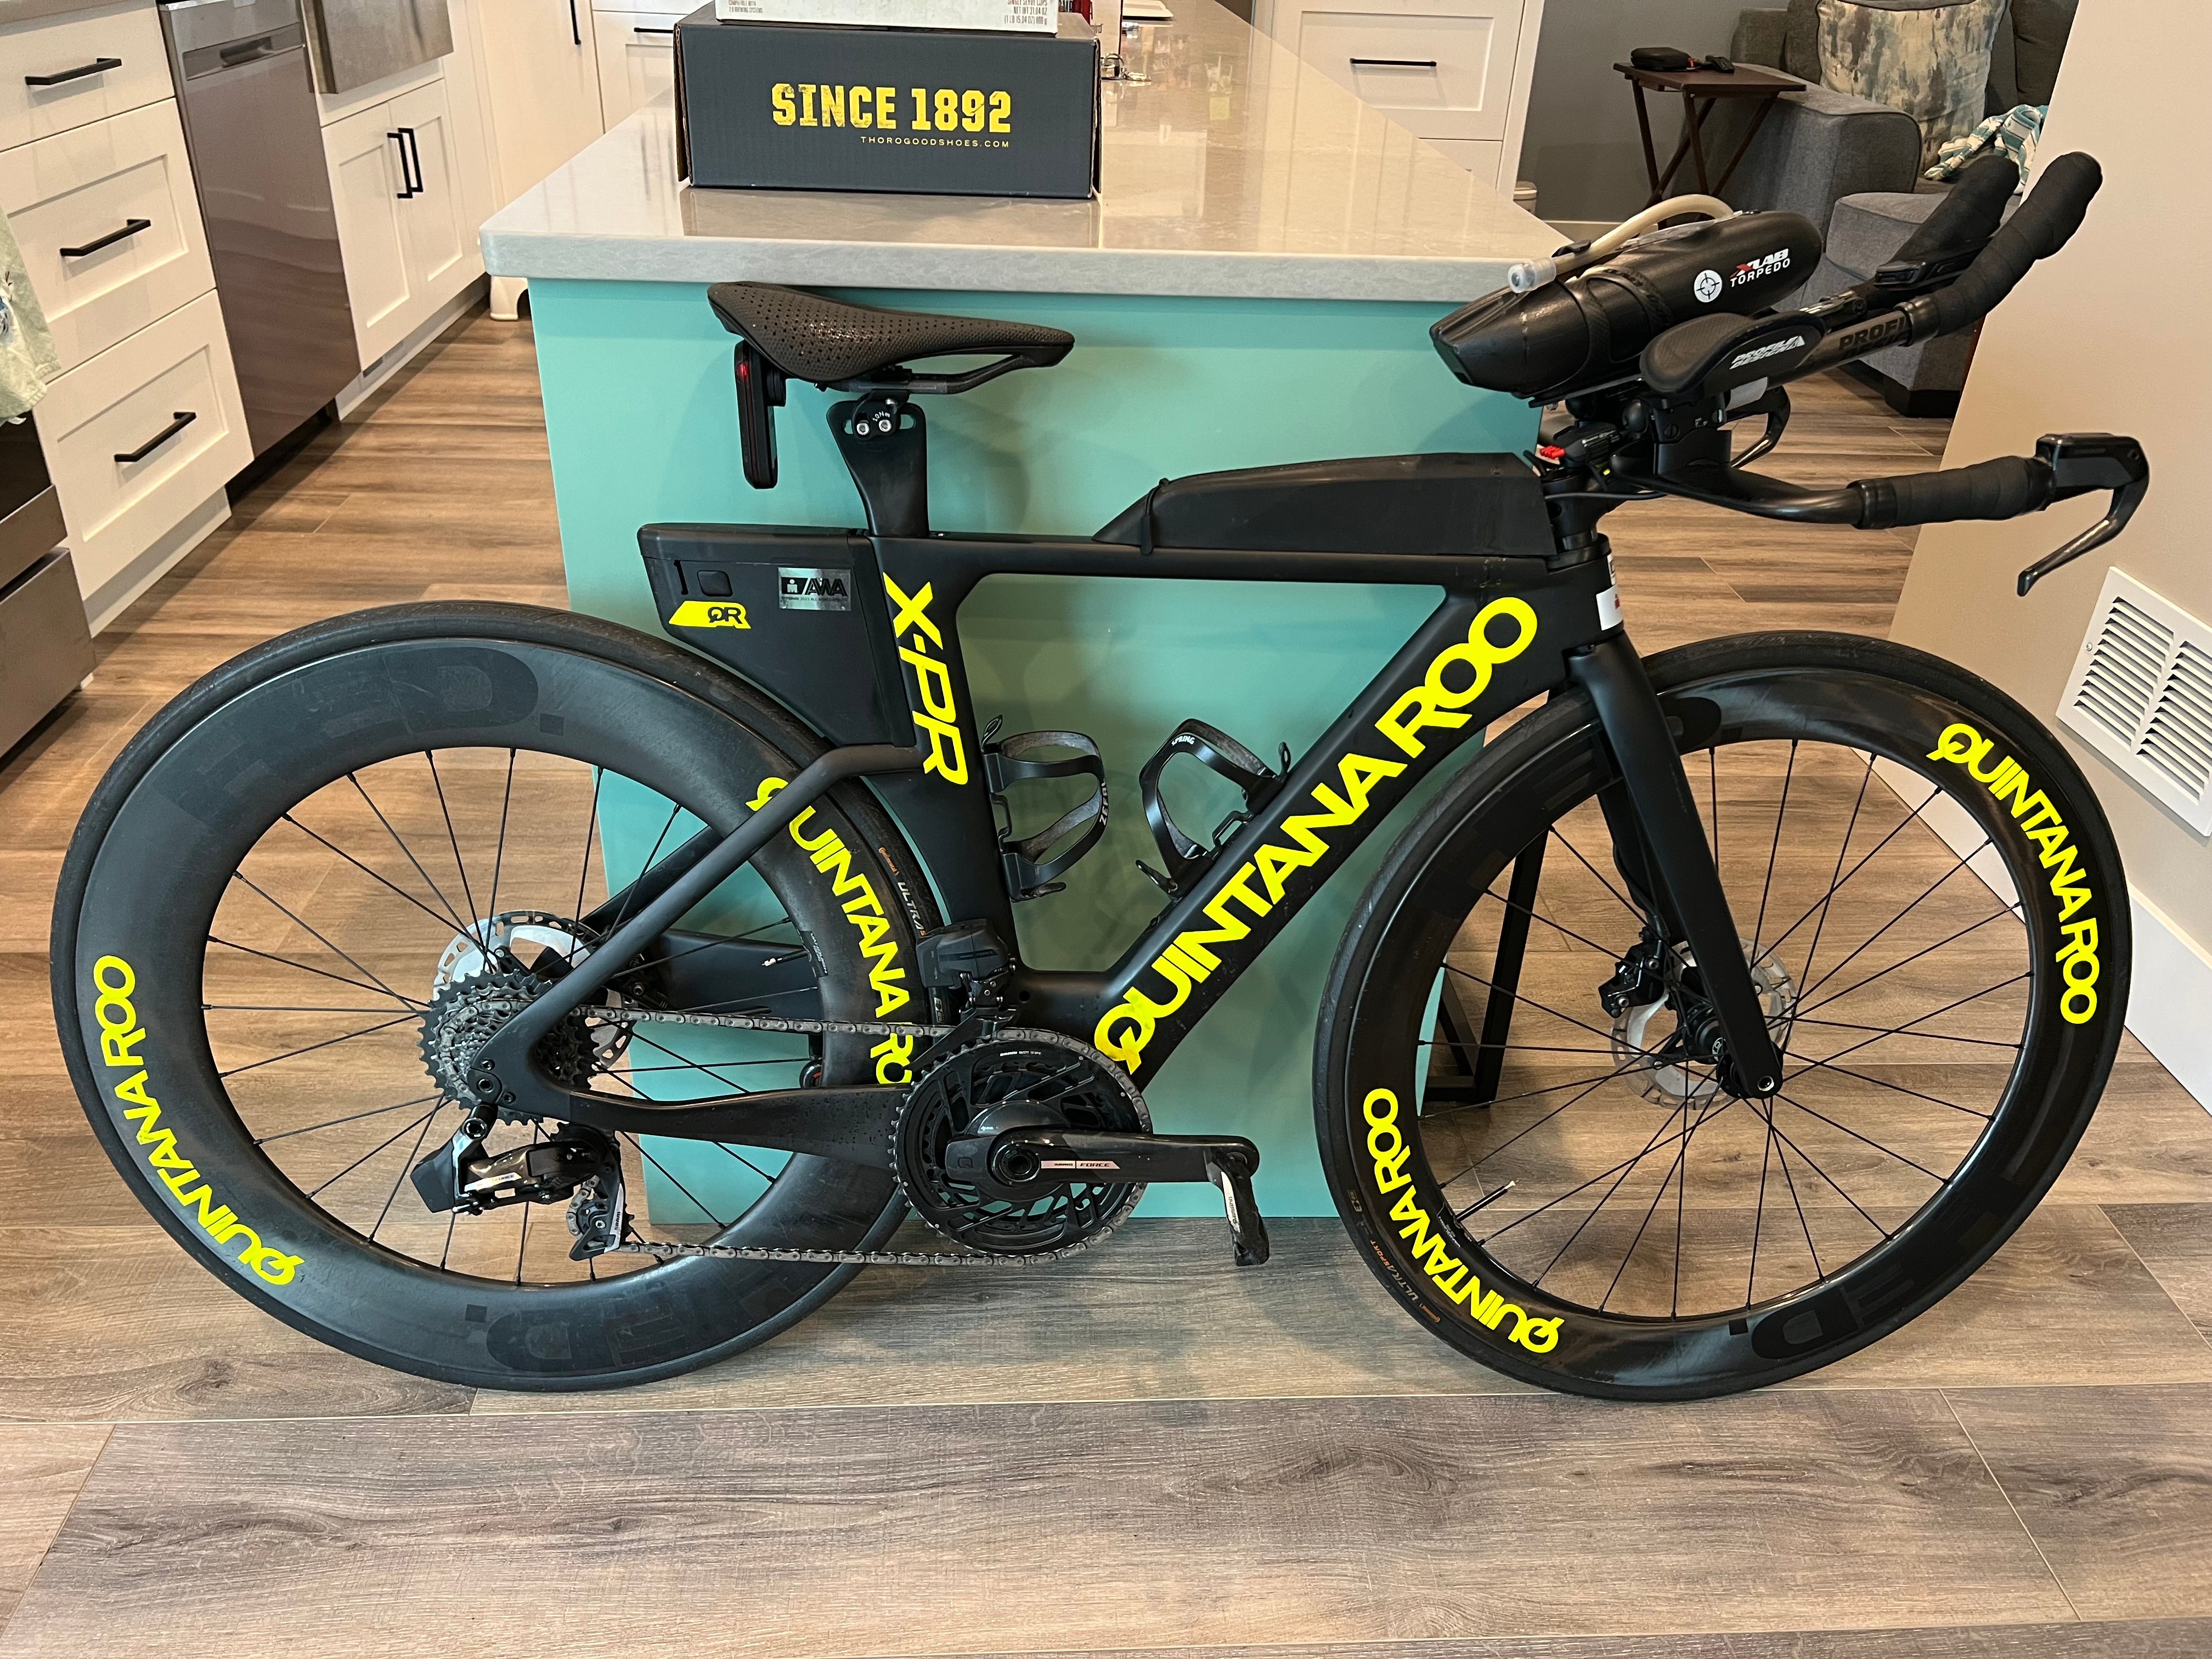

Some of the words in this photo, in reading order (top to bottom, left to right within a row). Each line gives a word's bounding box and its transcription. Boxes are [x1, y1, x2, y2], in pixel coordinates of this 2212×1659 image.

[1013, 6, 1022, 14] NET
[1022, 7, 1029, 15] WT
[771, 83, 896, 129] SINCE
[911, 88, 1012, 133] 1892
[861, 136, 1009, 148] THOROGOODSHOES.COM
[1730, 258, 1791, 287] TORPEDO
[882, 572, 968, 785] X-PR
[1094, 753, 1408, 1074] QUINTANA
[1375, 596, 1538, 758] ROO
[1926, 723, 2092, 922] QUINTANA
[2055, 917, 2100, 1024] ROO
[93, 955, 146, 1066] ROO
[114, 1069, 305, 1285] QUINTANA
[1363, 1088, 1412, 1194] ROO
[1389, 1185, 1565, 1353] QUINTANA
